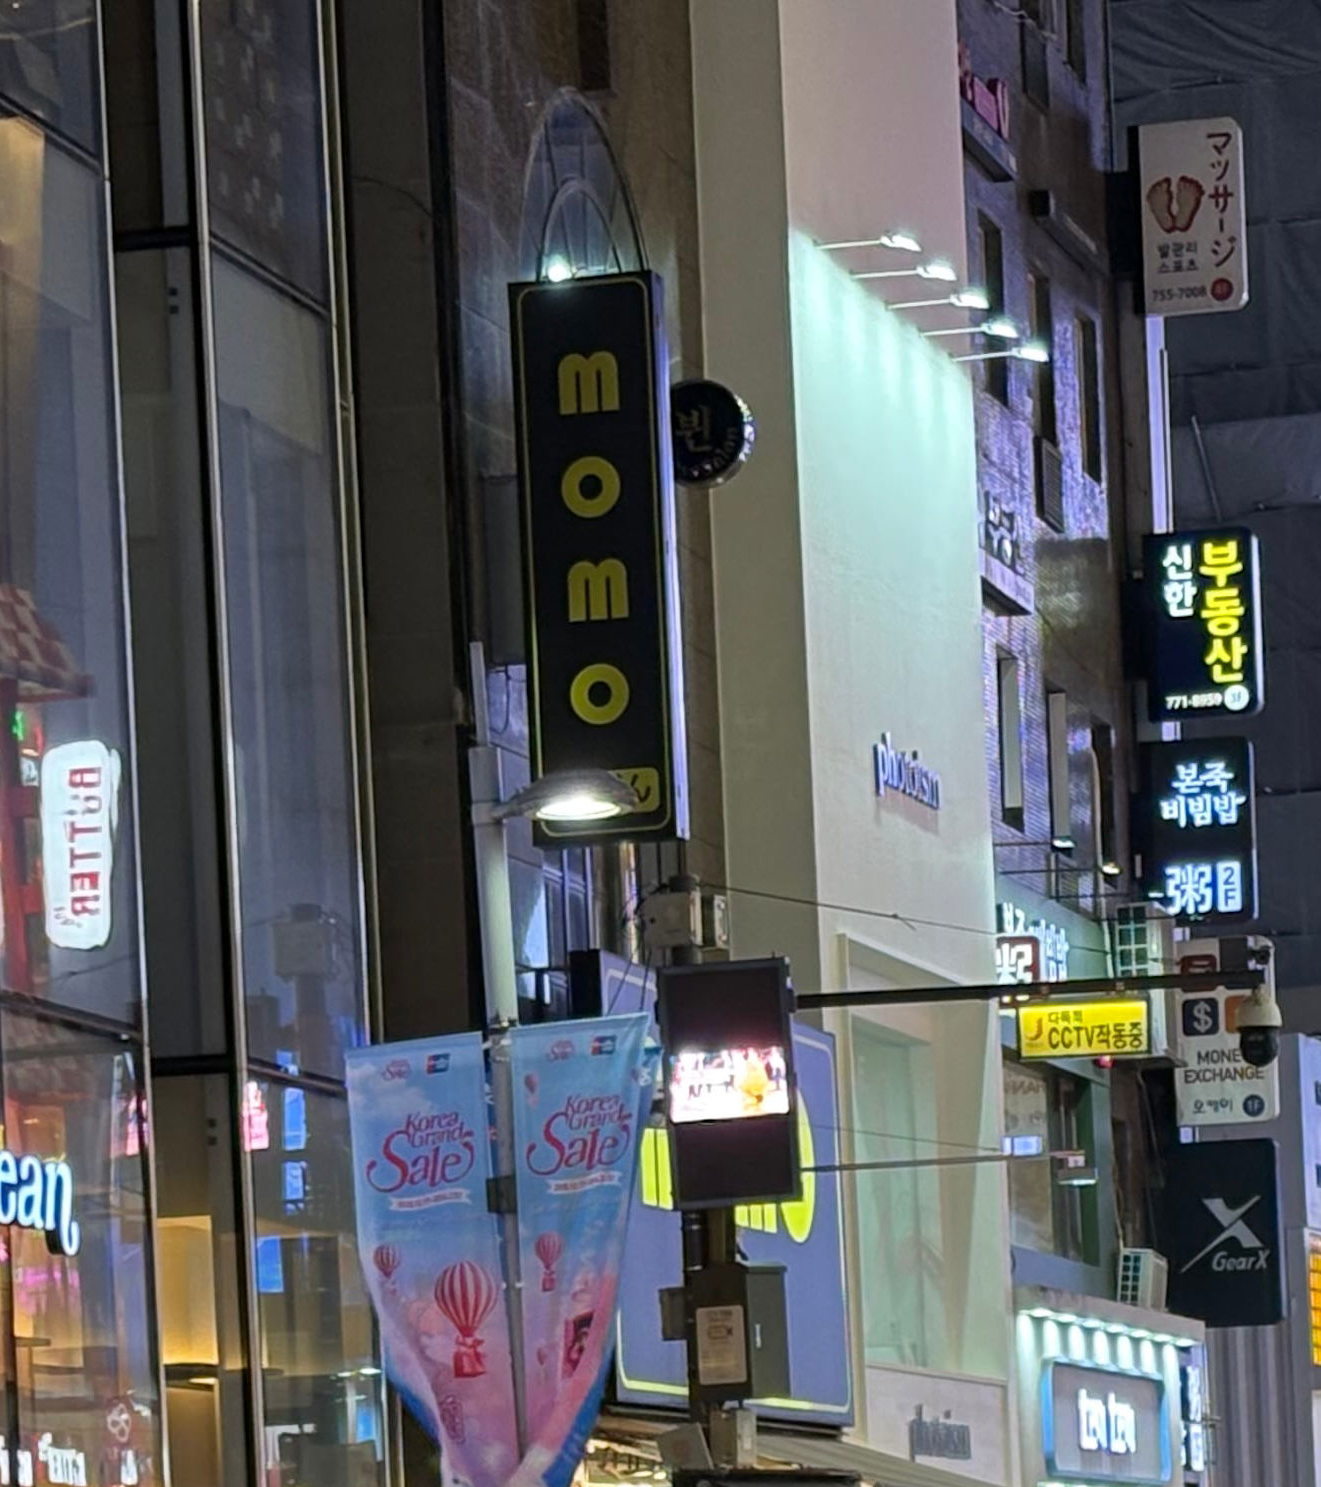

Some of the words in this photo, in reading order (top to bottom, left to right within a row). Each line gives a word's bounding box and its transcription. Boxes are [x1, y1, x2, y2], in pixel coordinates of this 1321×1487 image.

[557, 350, 631, 726] momo
[1162, 544, 1197, 618] 신한
[1199, 540, 1249, 683] 부동산
[1171, 760, 1235, 796] 본죽
[1159, 792, 1247, 829] 비빔밥
[1164, 863, 1213, 916] 粥
[1047, 1021, 1143, 1050] CCTV작동중
[1196, 1047, 1243, 1065] MONE
[1183, 1065, 1265, 1085] EXCHANGE
[404, 1112, 459, 1132] Korea
[565, 1093, 621, 1116] Korea
[568, 1109, 629, 1131] Grand
[409, 1124, 465, 1149] Grand
[526, 1115, 631, 1176] Sale
[366, 1132, 475, 1193] Sale
